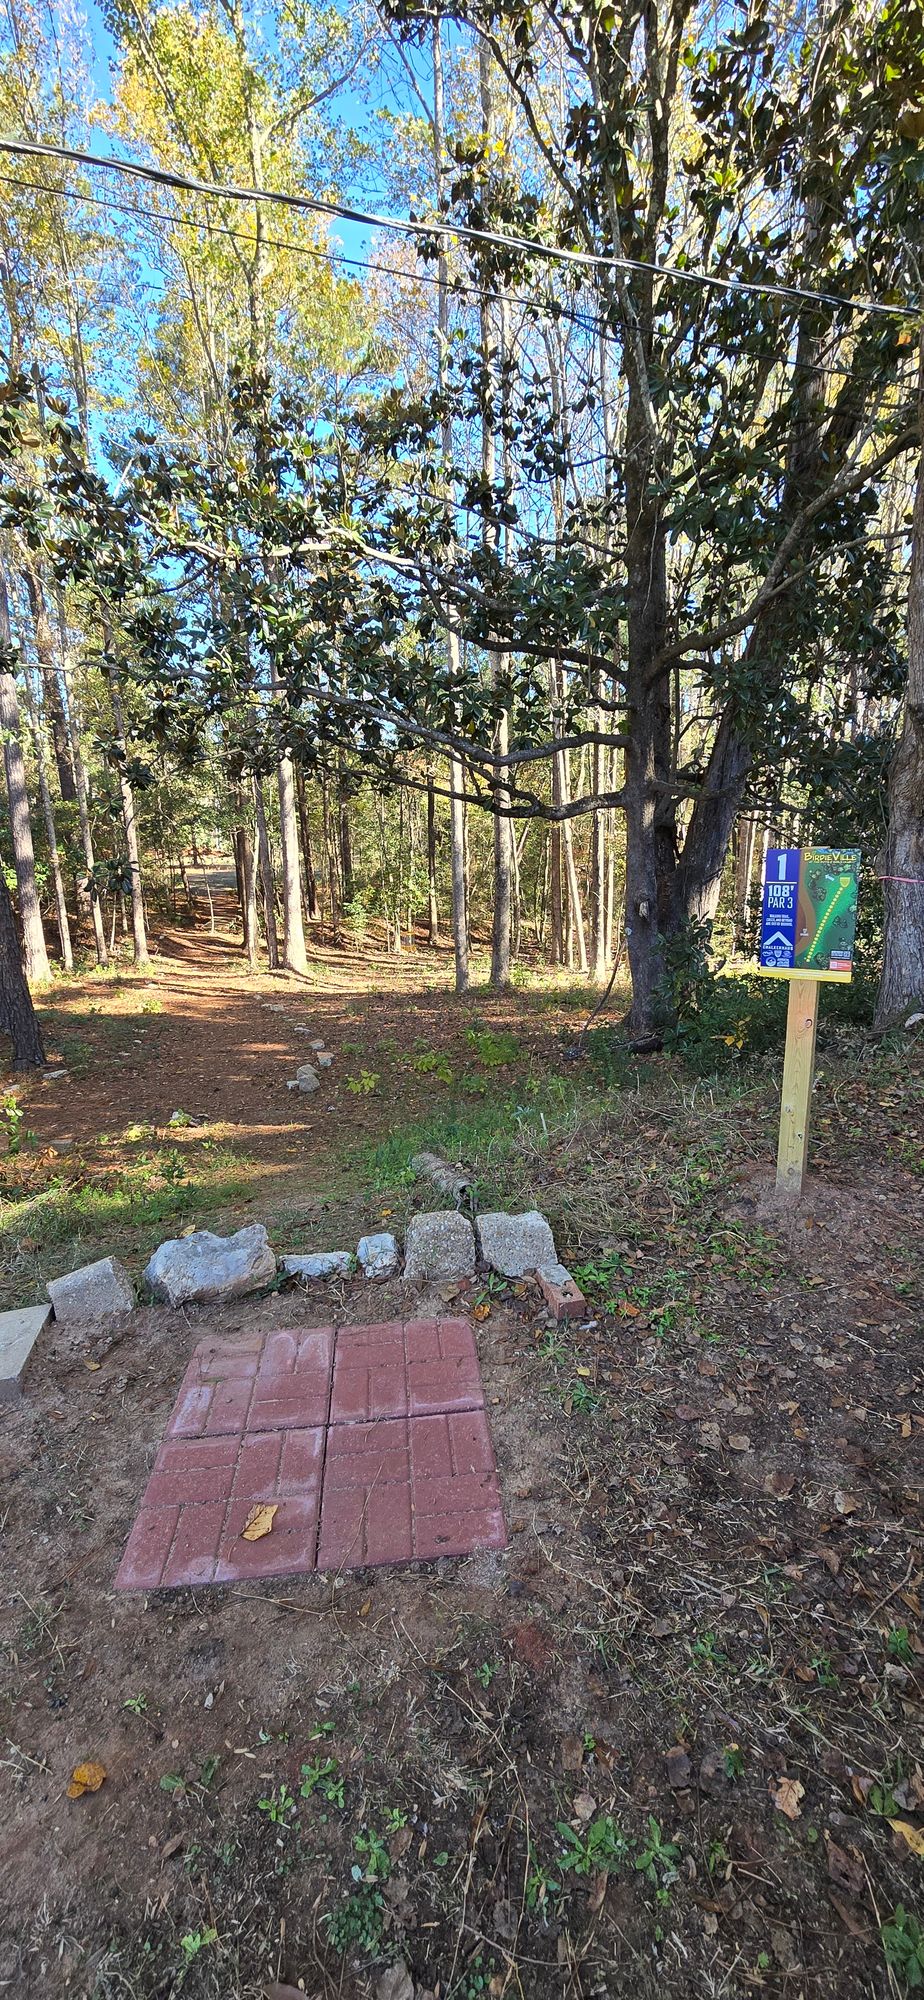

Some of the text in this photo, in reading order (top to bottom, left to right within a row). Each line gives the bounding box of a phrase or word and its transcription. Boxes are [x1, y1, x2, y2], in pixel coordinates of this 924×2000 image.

[777, 853, 787, 881] 1
[768, 885, 794, 897] 108'
[767, 897, 793, 908] PAR 3
